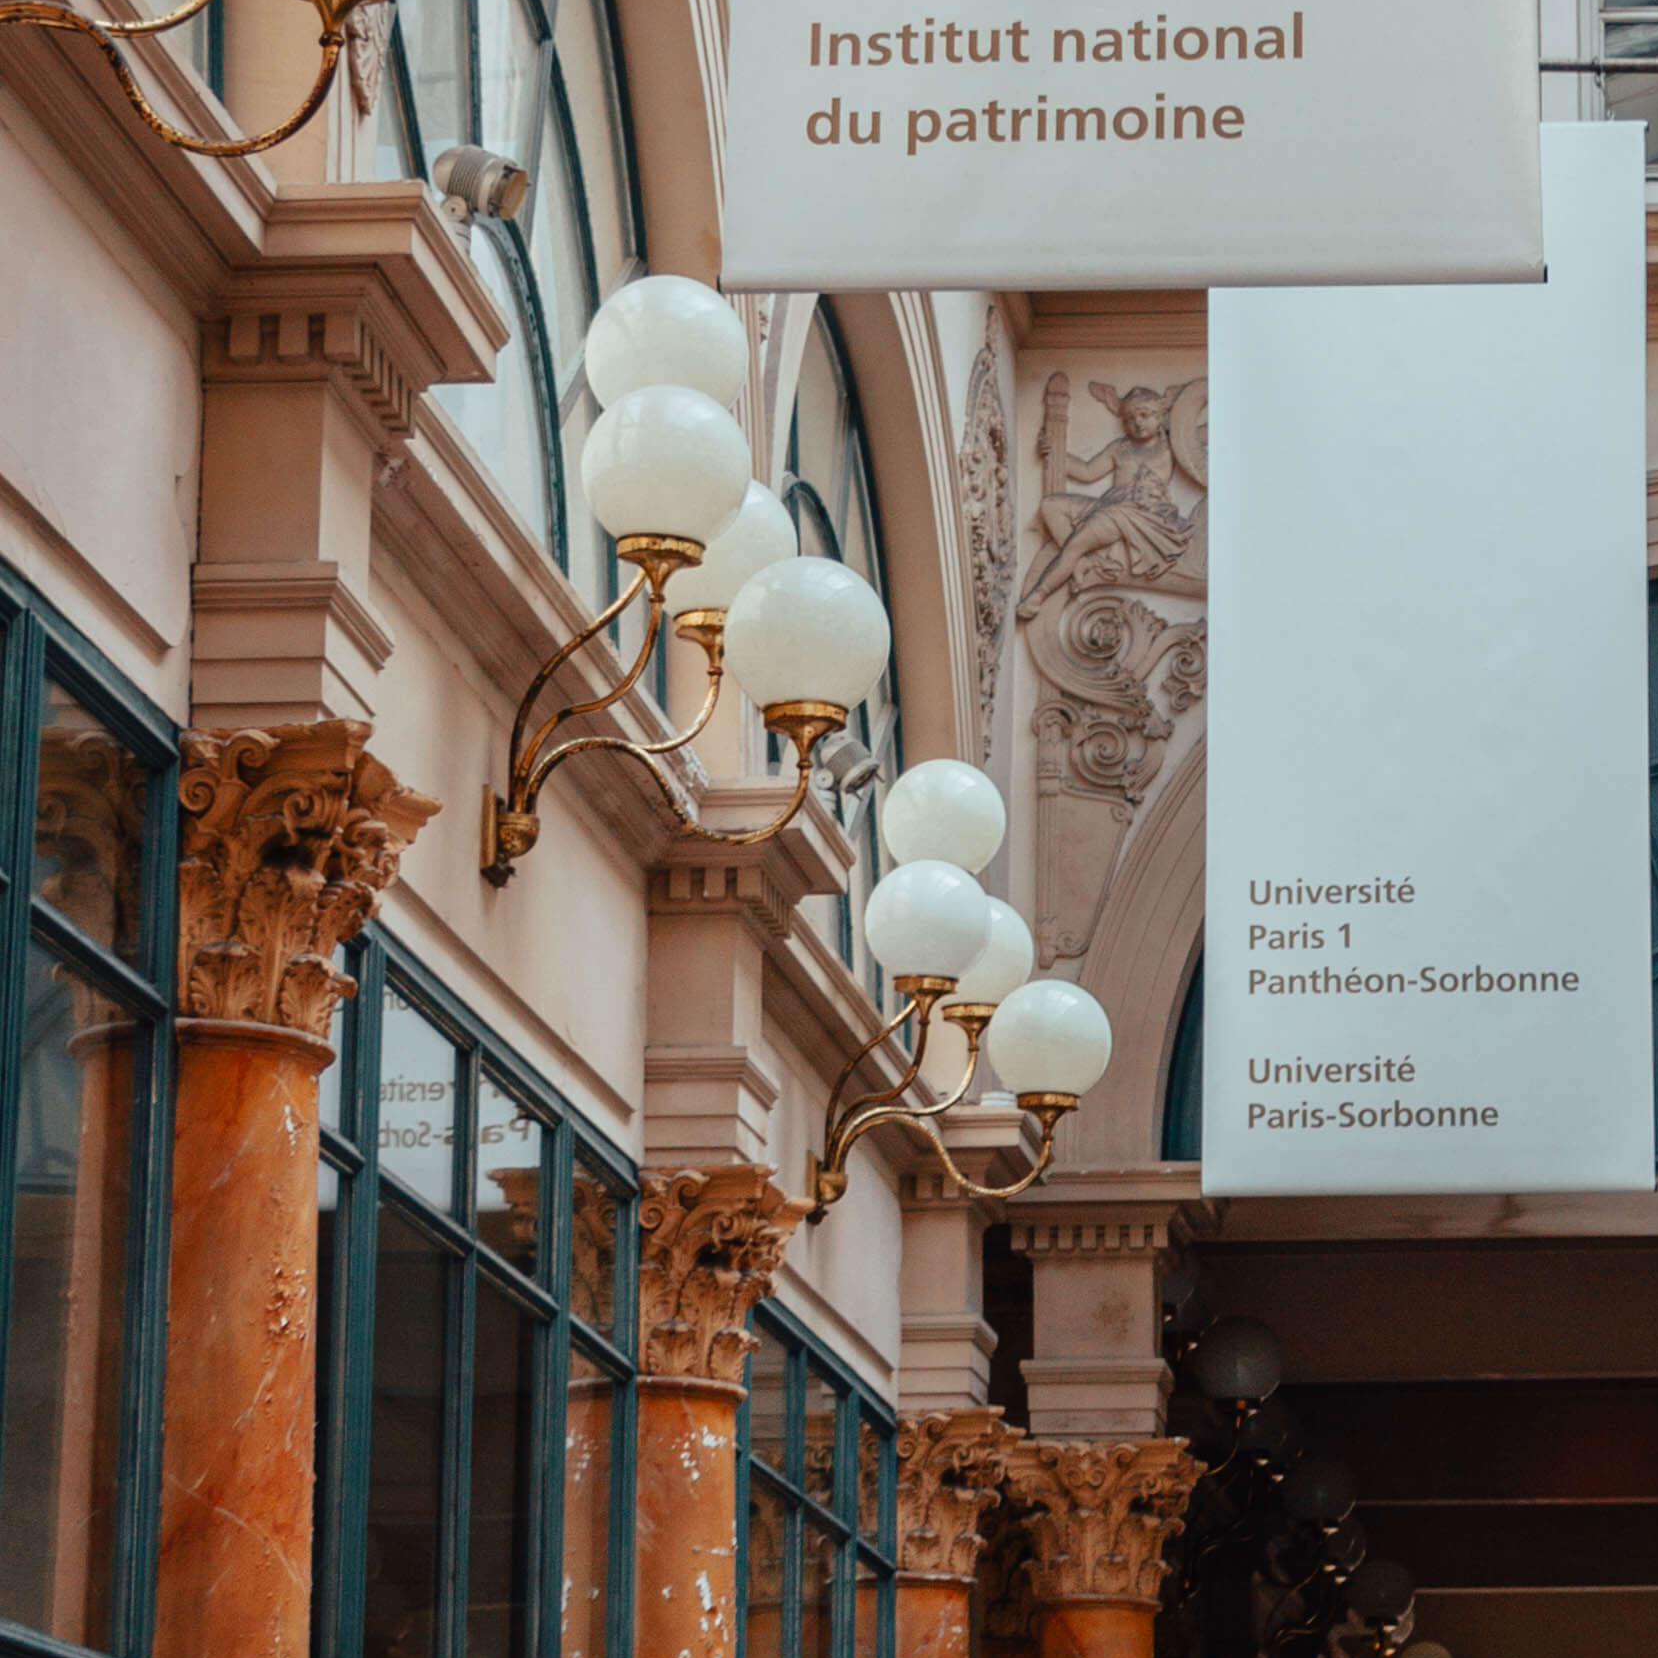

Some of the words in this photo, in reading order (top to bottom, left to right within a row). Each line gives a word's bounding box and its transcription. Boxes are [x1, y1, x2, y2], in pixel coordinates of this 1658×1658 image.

[810, 17, 1030, 67] Institut
[1053, 11, 1303, 63] national
[806, 97, 881, 145] du
[906, 92, 1245, 156] patrimoine
[1249, 876, 1416, 906] Université
[1249, 922, 1325, 951] Paris
[1338, 922, 1351, 949] 1
[1249, 964, 1580, 995] Panthéon-Sorbonne
[1249, 1054, 1416, 1084] Université
[1248, 1099, 1499, 1129] Paris-Sorbonne
